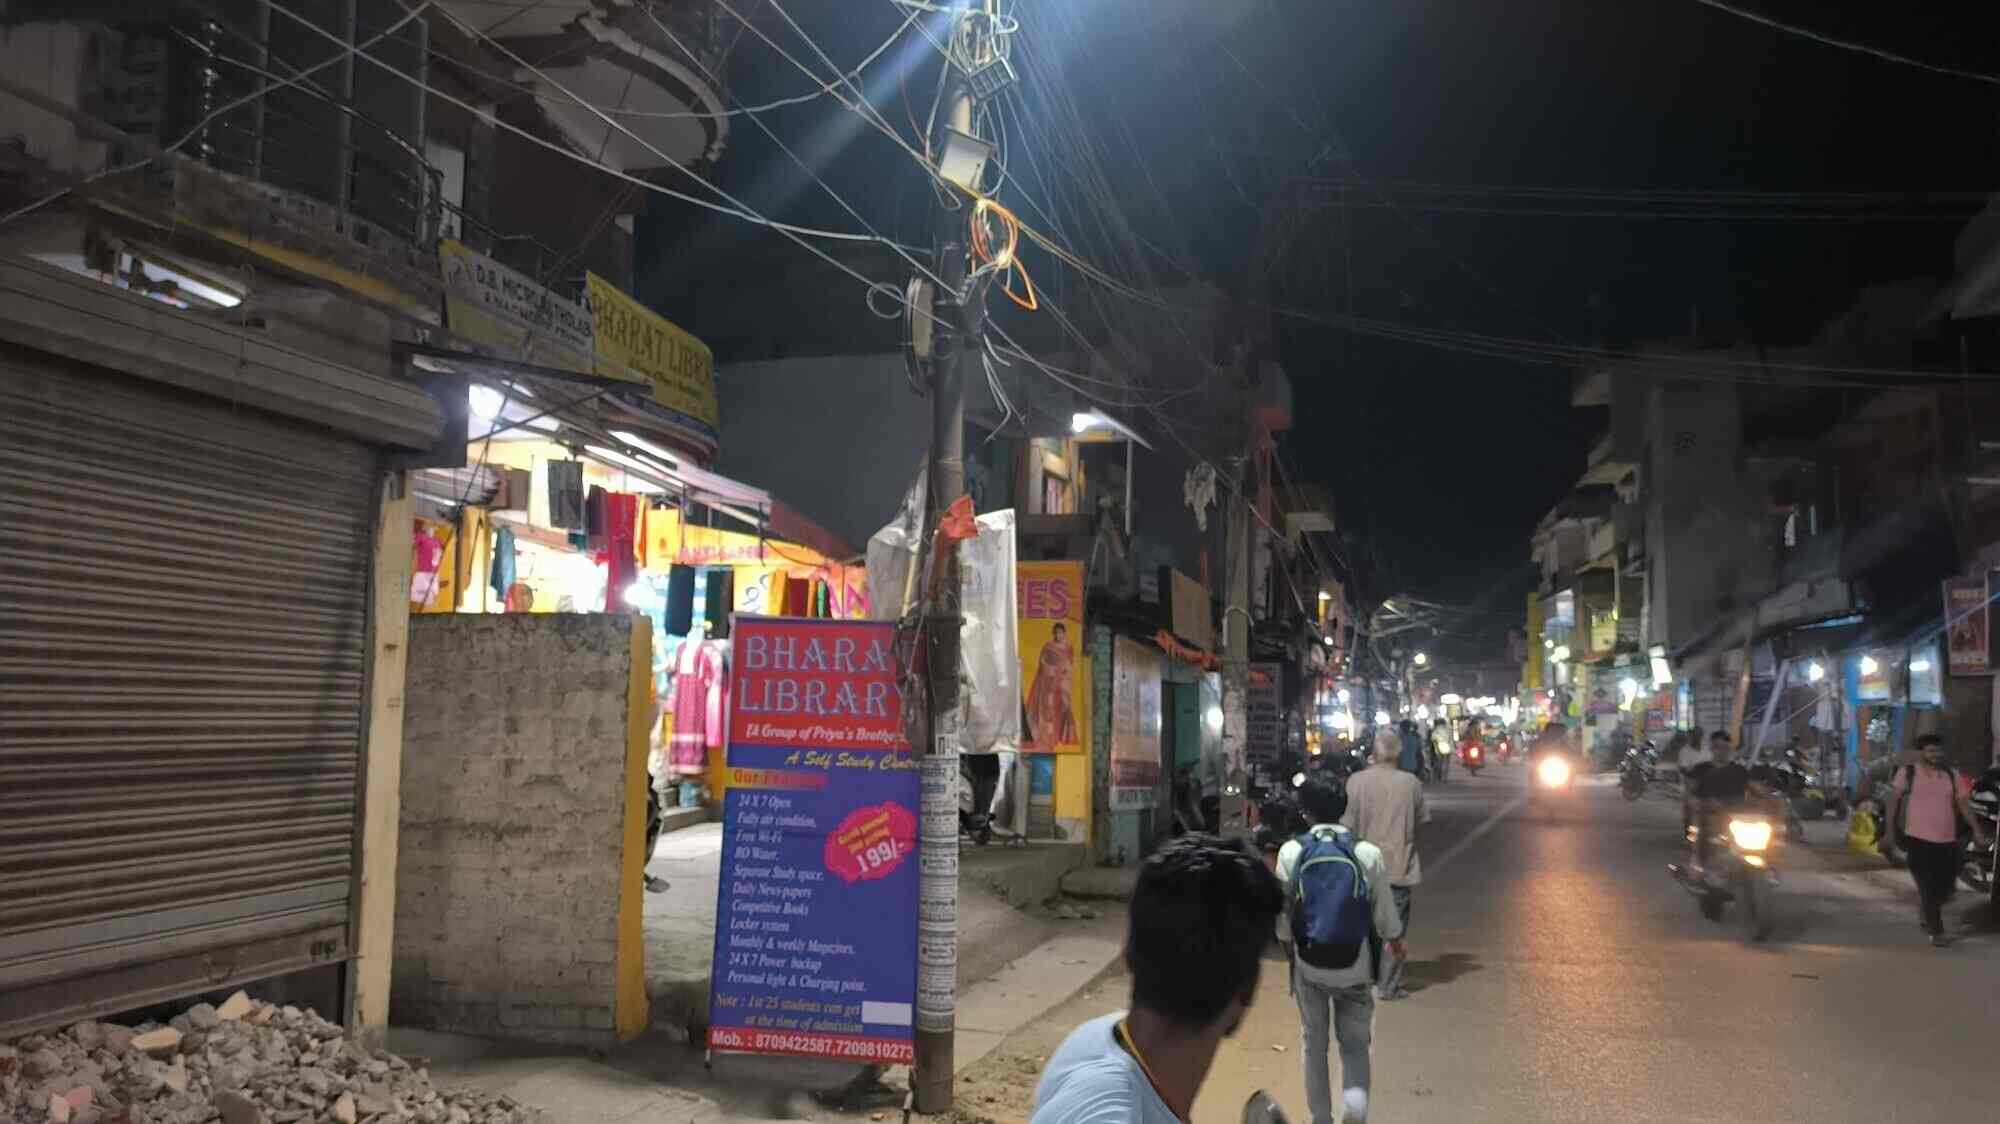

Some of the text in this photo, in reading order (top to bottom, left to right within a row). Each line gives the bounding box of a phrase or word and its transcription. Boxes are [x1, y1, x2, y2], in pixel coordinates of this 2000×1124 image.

[1020, 580, 1070, 619] ES
[745, 635, 905, 672] BHARA
[762, 724, 797, 741] Group
[799, 726, 812, 741] of
[813, 726, 853, 742] Priya's
[785, 751, 799, 765] A
[803, 751, 833, 769] Self
[836, 752, 875, 770] Study
[738, 793, 750, 807] 24
[737, 811, 760, 828] Fully
[736, 829, 756, 843] Free
[732, 881, 757, 897] Daily
[730, 916, 760, 930] Locker
[711, 1031, 744, 1046] Mob.
